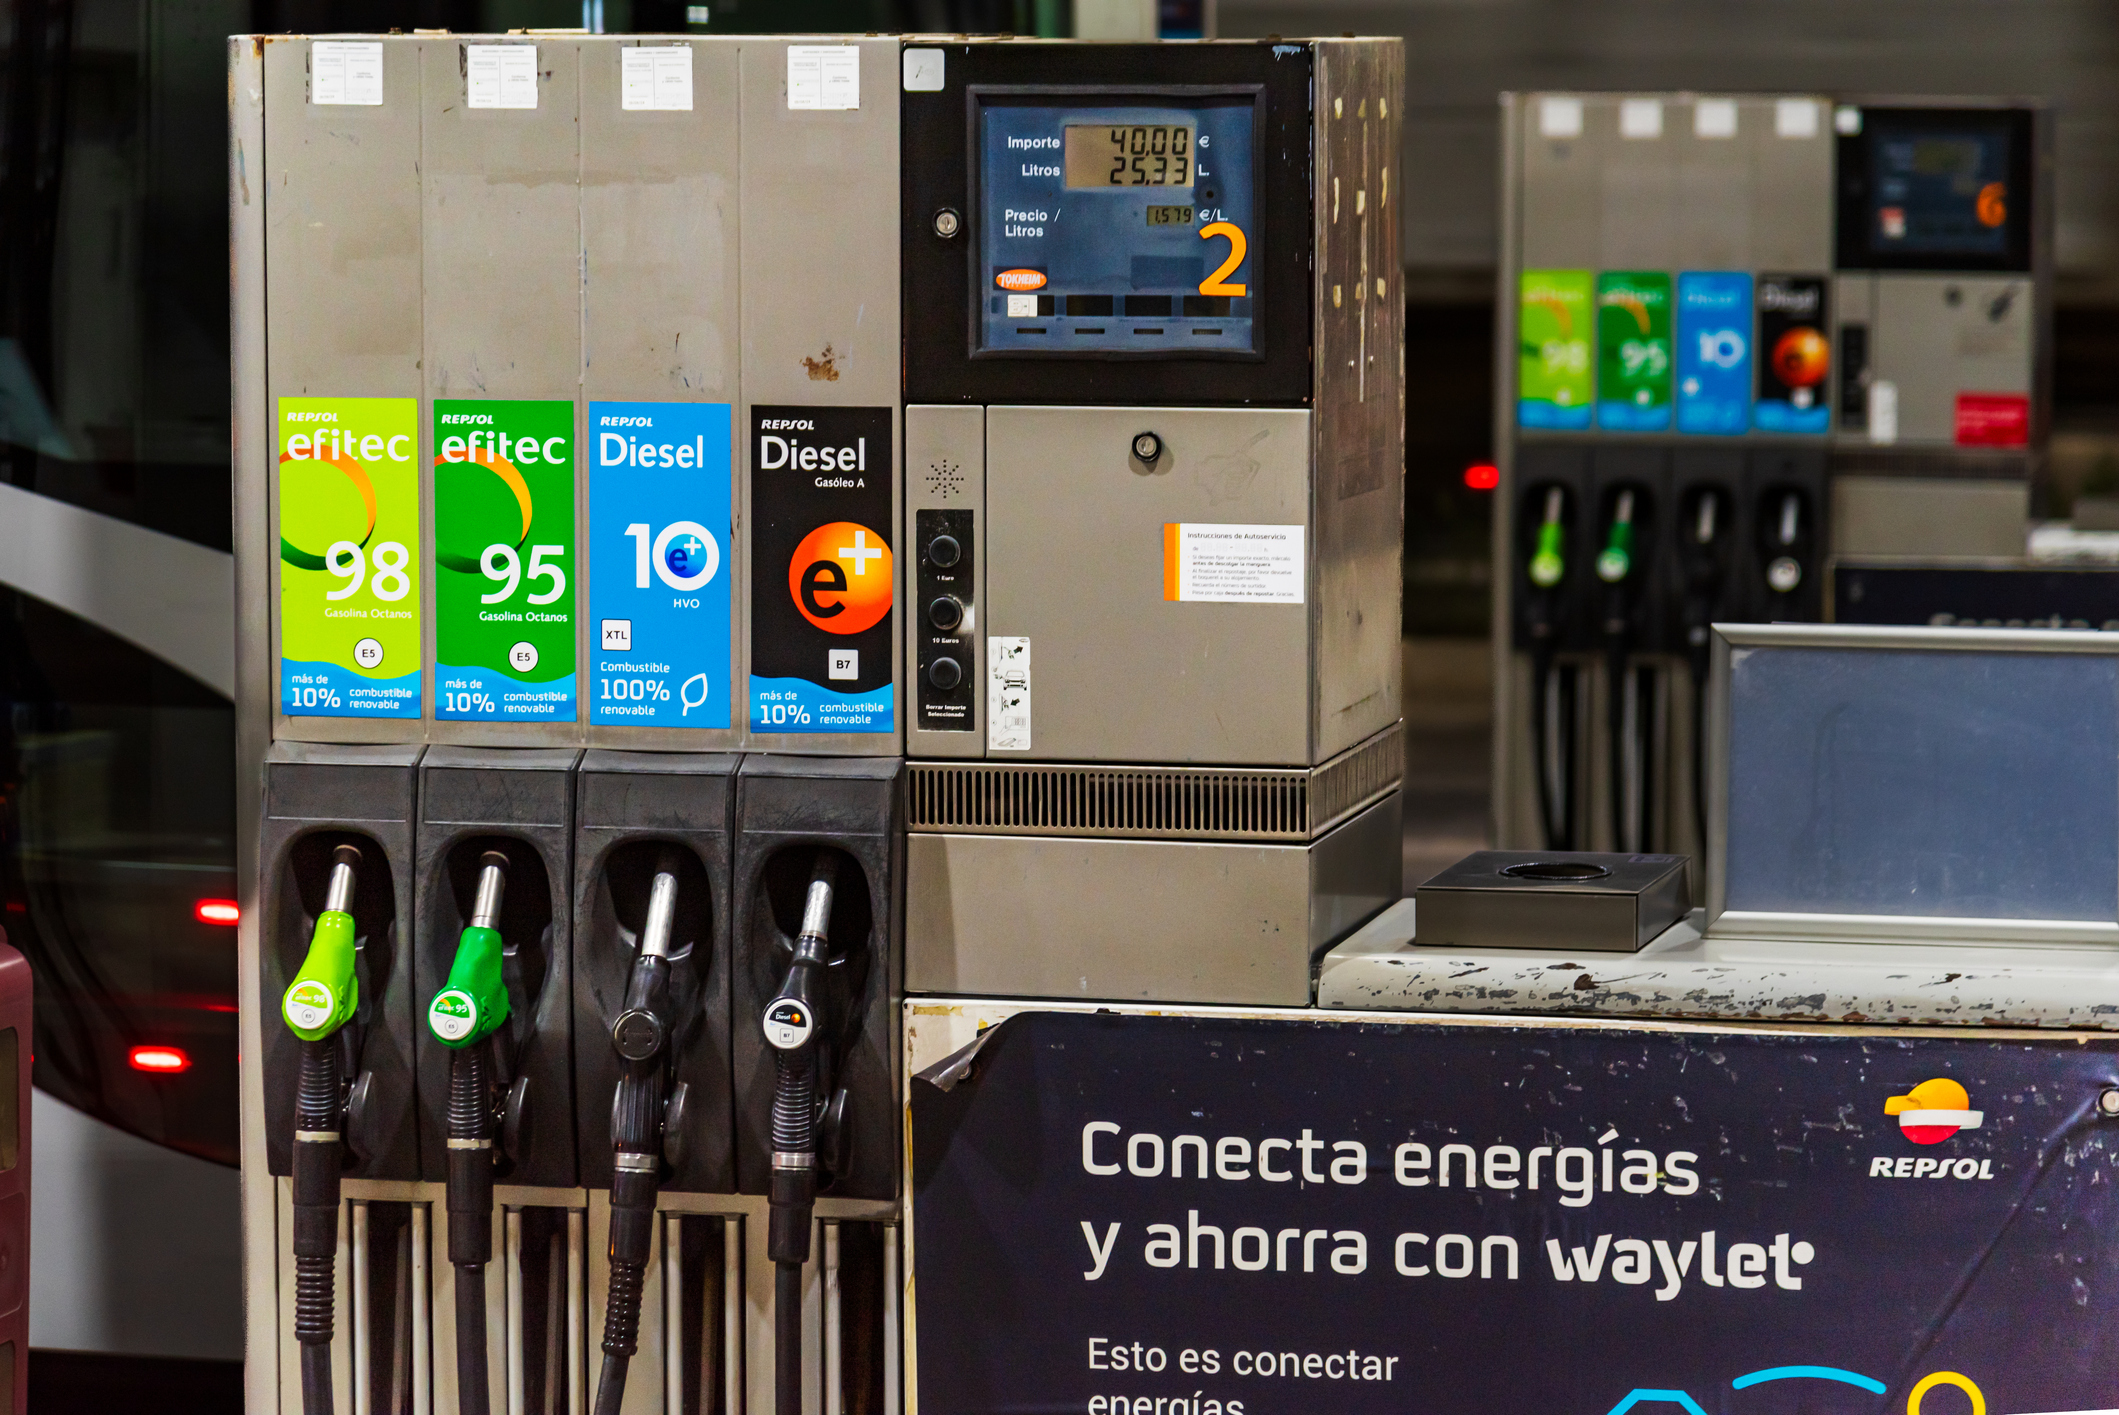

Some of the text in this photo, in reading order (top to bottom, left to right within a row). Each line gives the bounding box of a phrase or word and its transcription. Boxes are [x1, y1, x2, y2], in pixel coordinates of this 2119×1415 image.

[1008, 136, 1061, 150] Importe
[1198, 136, 1210, 148] €
[1022, 156, 1209, 186] Litros 25,33 L.
[1976, 181, 2007, 228] 6
[1005, 209, 1048, 222] Precio
[1054, 209, 1061, 222] /
[1199, 208, 1228, 222] €/L.
[1005, 225, 1044, 237] Litros
[1198, 222, 1247, 297] 2
[998, 273, 1041, 287] TOKHEIM
[287, 412, 338, 422] REPSOL
[441, 414, 494, 425] REPSOL
[600, 416, 653, 427] REPSOL
[761, 419, 815, 430] REPSOL
[287, 428, 410, 462] efitec
[441, 430, 566, 464] efitec
[600, 432, 703, 468] Diesel
[761, 436, 866, 471] Diesel
[814, 476, 865, 488] Gasóleo A
[624, 521, 720, 591] 10
[325, 540, 410, 601] 98
[480, 543, 566, 605] 95
[674, 599, 700, 609] HVO
[325, 608, 412, 619] Gasolina Octanos
[479, 611, 568, 623] Gasolina Octanos
[606, 630, 628, 640] XTL
[362, 648, 376, 658] E5
[517, 652, 531, 662] E5
[600, 661, 670, 673] Combustible
[836, 660, 850, 670] B7
[292, 674, 328, 684] más de
[445, 679, 482, 689] más de
[349, 688, 412, 698] combustible
[600, 678, 670, 701] 100%
[760, 690, 797, 701] más de
[292, 688, 341, 708] 10%
[445, 692, 495, 713] 10%
[504, 691, 567, 702] combustible
[349, 699, 400, 710] renovable
[504, 703, 555, 714] renovable
[600, 705, 655, 716] renovable
[819, 702, 884, 713] combustible
[760, 704, 811, 725] 10%
[819, 714, 871, 725] renovable
[313, 995, 326, 1003] 98
[455, 1004, 467, 1013] 95
[1082, 1121, 1699, 1207] Conecta energías
[1869, 1156, 1995, 1180] REPSOL
[1081, 1210, 1814, 1302] y ahorra con waylet
[1088, 1337, 1399, 1381] Esto es conectar
